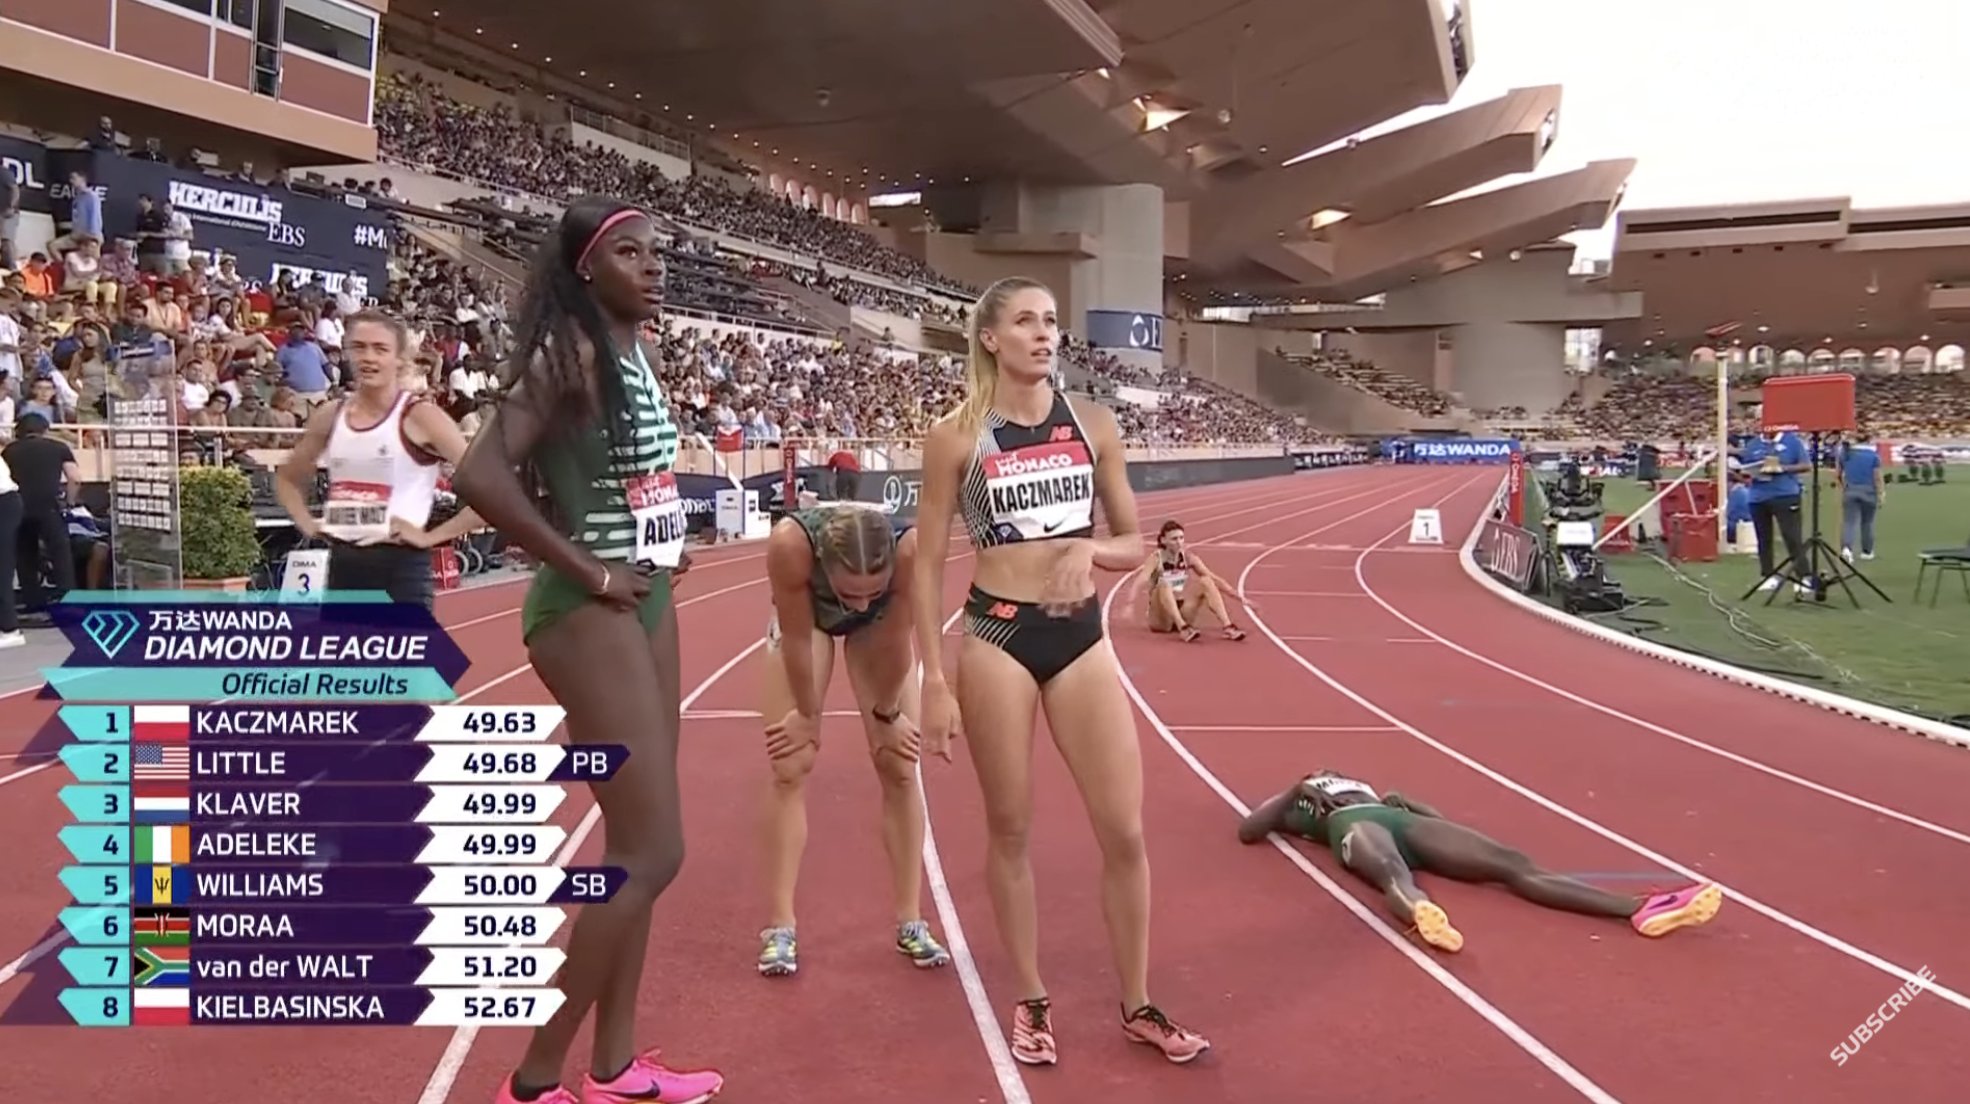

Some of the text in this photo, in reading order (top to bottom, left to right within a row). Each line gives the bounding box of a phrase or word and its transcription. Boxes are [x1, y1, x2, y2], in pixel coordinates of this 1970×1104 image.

[267, 221, 306, 248] EBS
[995, 452, 1073, 477] MONACO
[992, 471, 1091, 515] KACZMAREK
[1422, 521, 1430, 537] 1
[297, 573, 311, 597] 3
